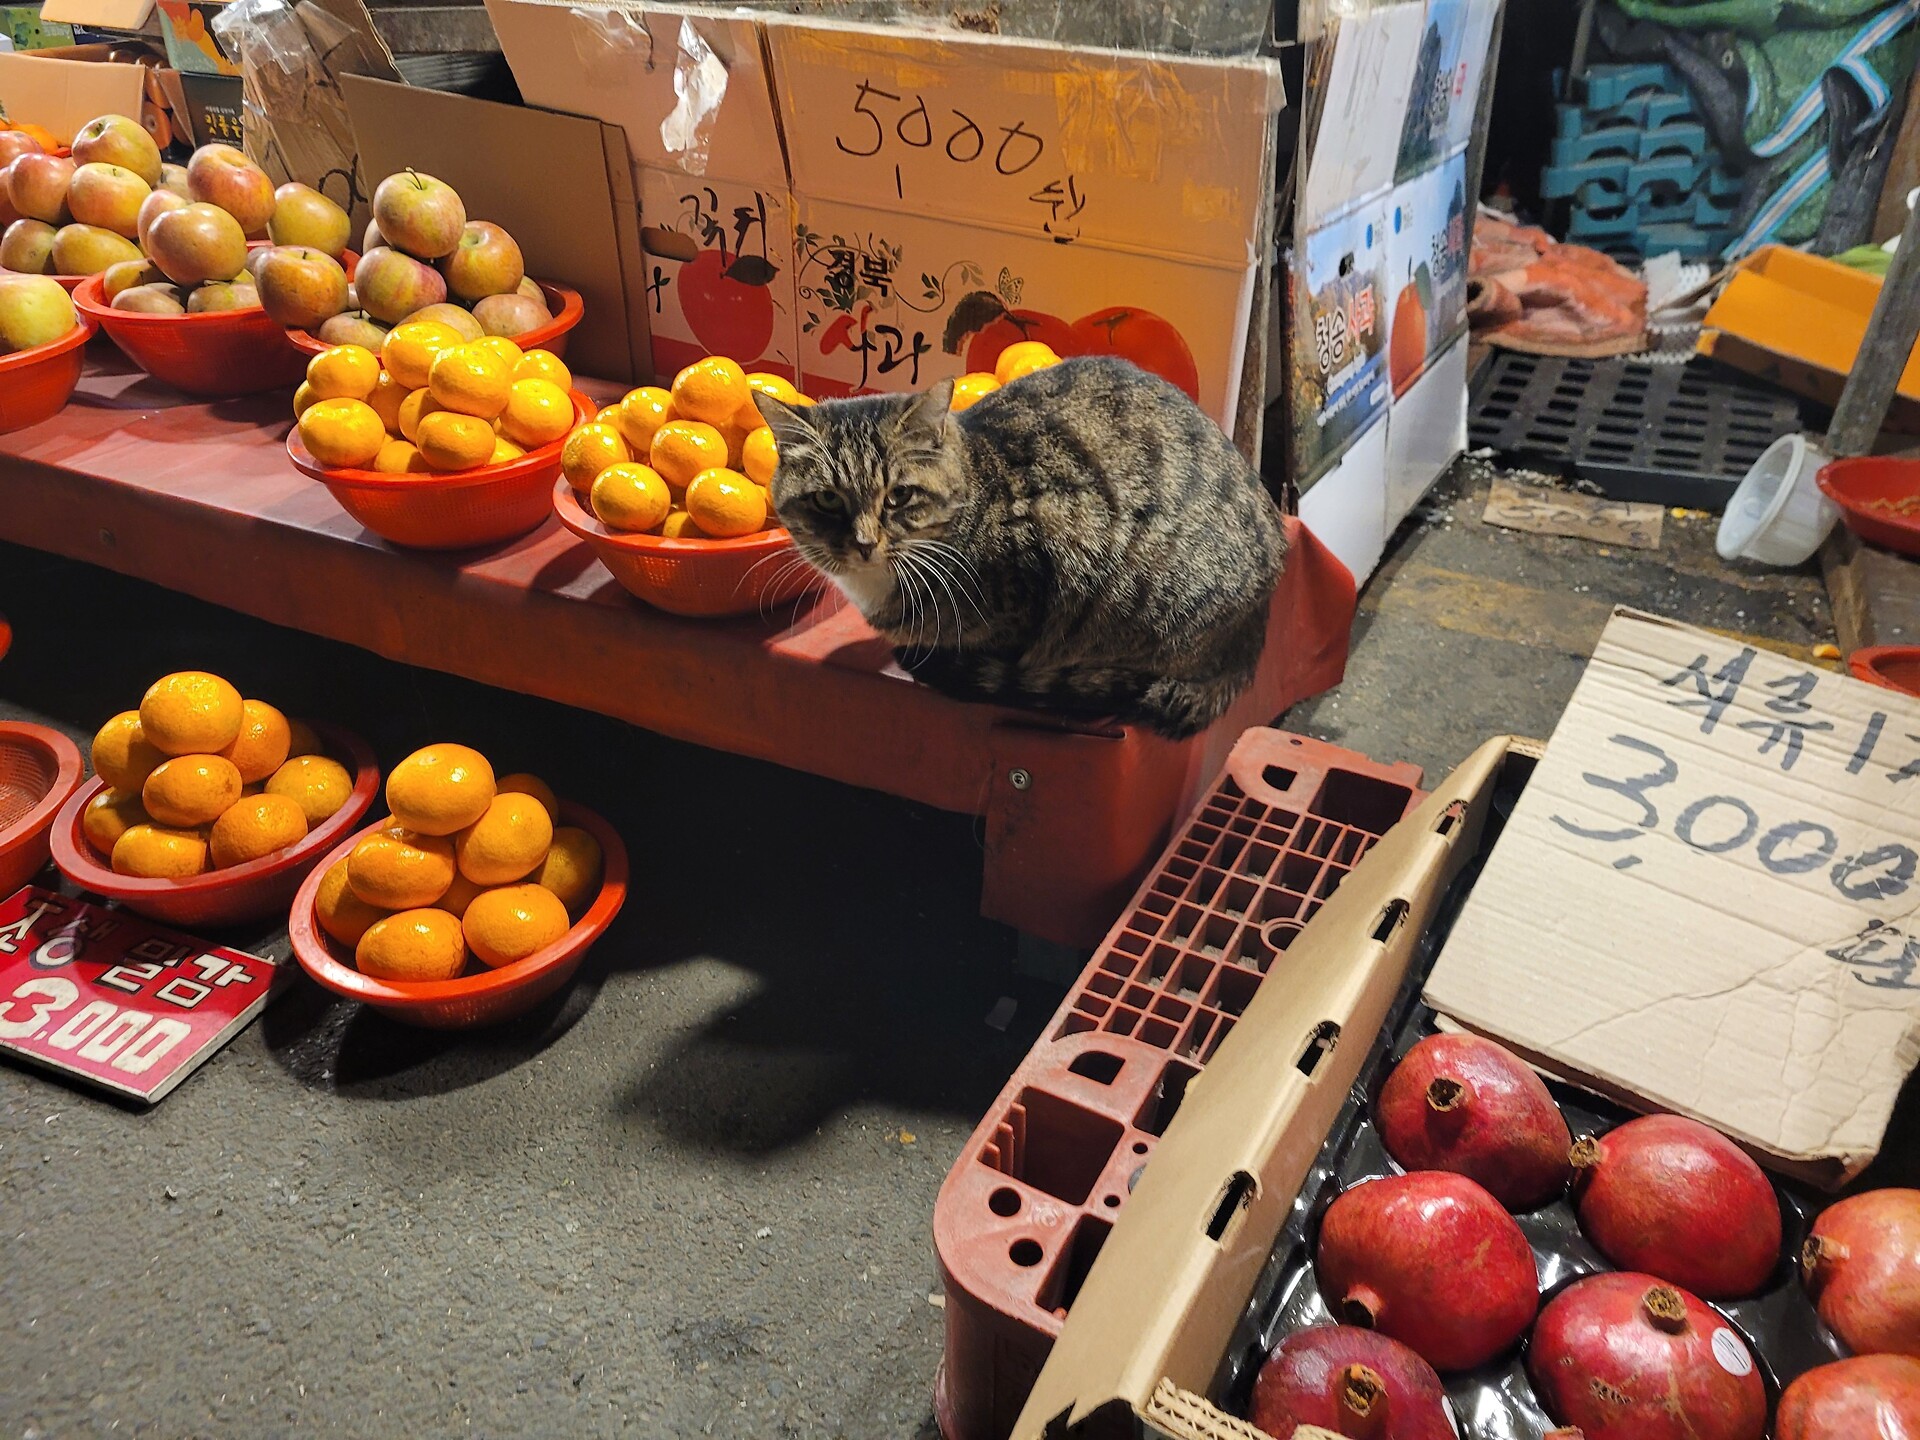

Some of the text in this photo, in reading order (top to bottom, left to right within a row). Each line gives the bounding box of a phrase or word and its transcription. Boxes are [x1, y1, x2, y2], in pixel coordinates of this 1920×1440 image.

[819, 304, 932, 393] 사과
[1658, 647, 1834, 772] 석류
[1549, 734, 1919, 901] 3,000
[99, 939, 253, 1009] 밀감
